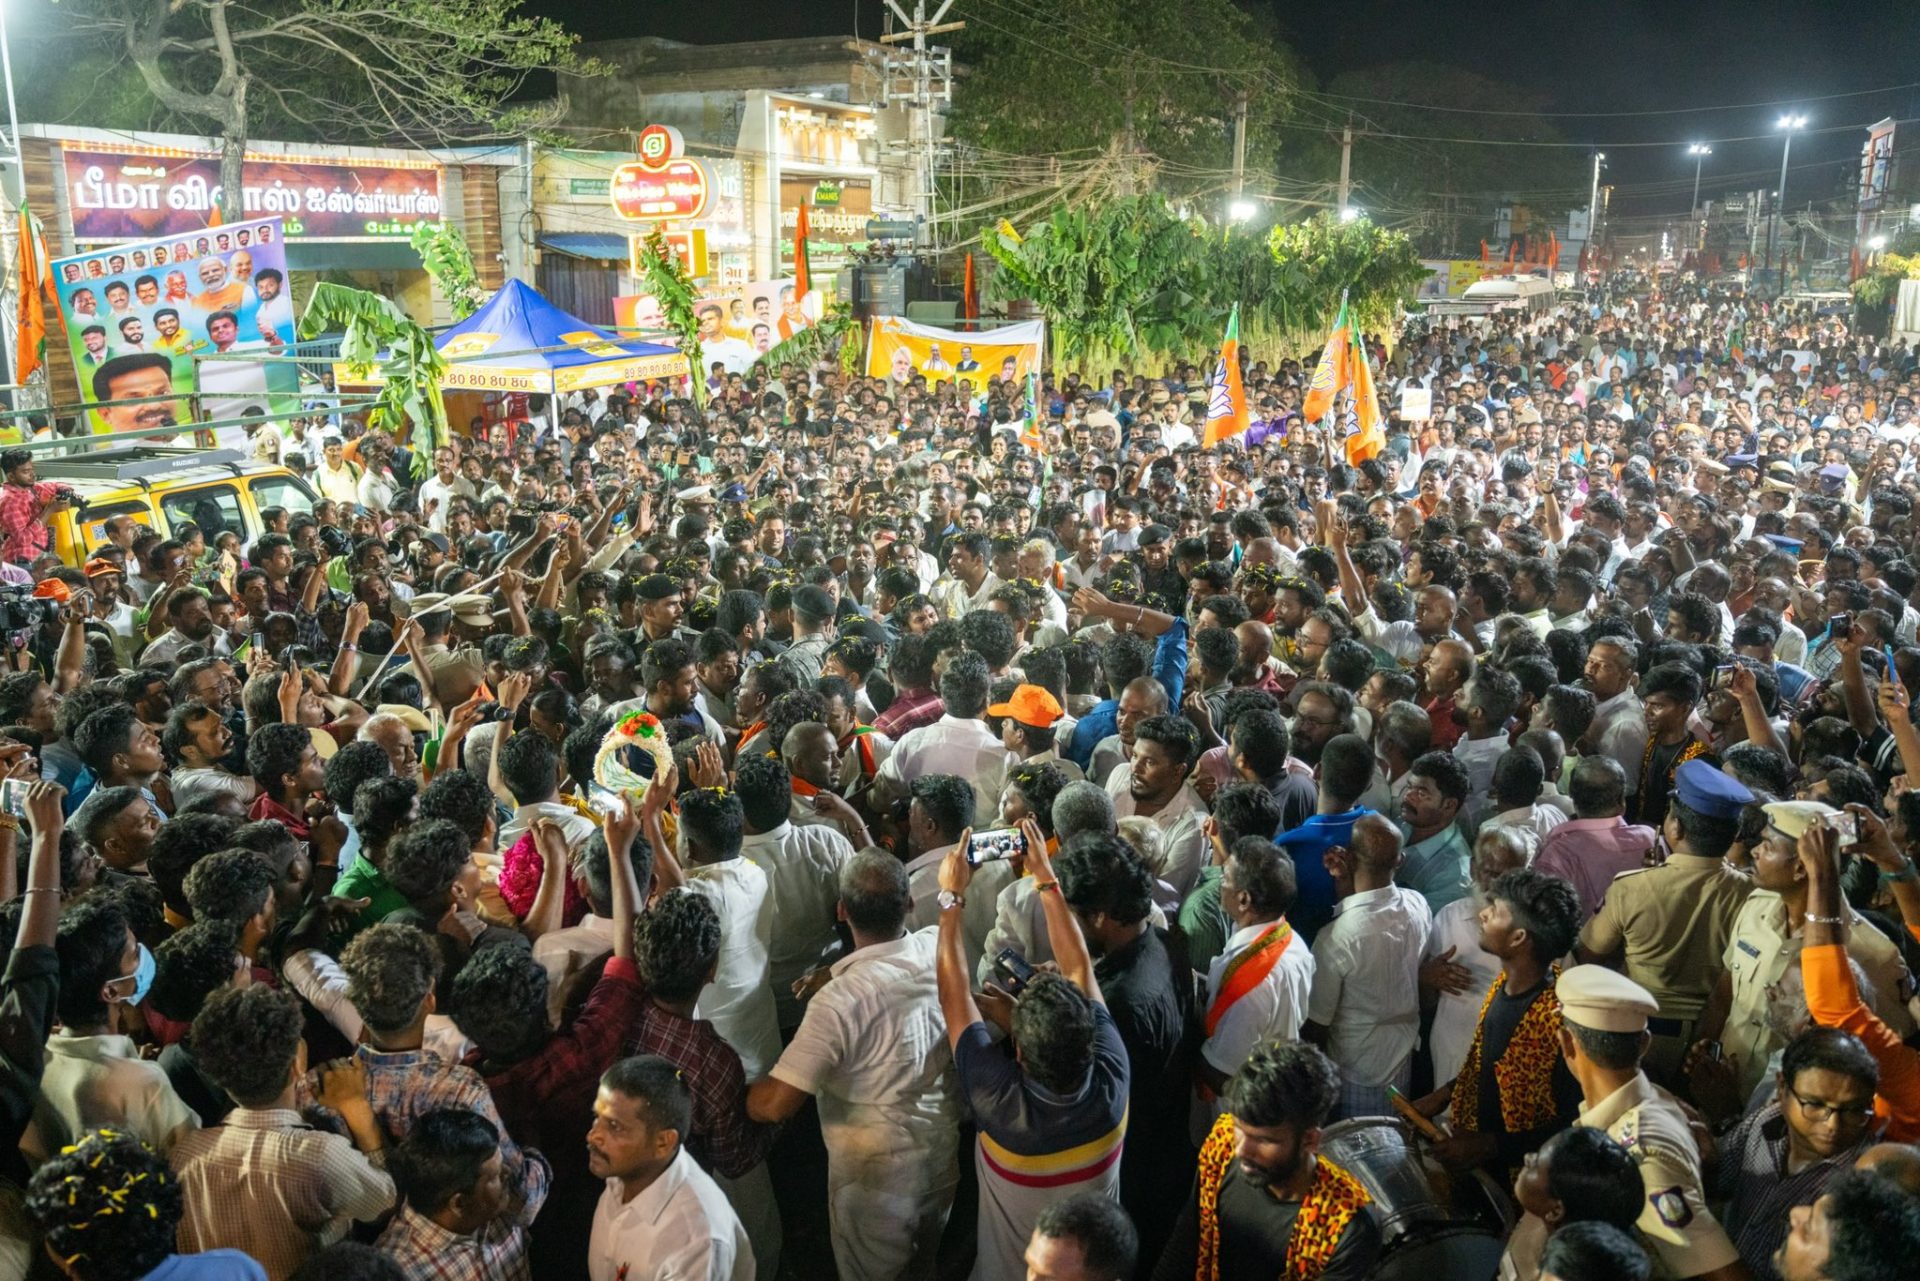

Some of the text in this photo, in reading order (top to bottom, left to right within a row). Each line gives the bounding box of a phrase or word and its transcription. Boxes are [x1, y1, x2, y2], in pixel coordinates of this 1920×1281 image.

[74, 166, 161, 209] பீமா
[167, 174, 301, 212] விாஸ்
[637, 366, 648, 377] 80
[662, 363, 672, 374] 80
[449, 373, 466, 385] 80
[469, 374, 486, 386] 80
[490, 375, 507, 387] 80
[511, 377, 528, 388] 80
